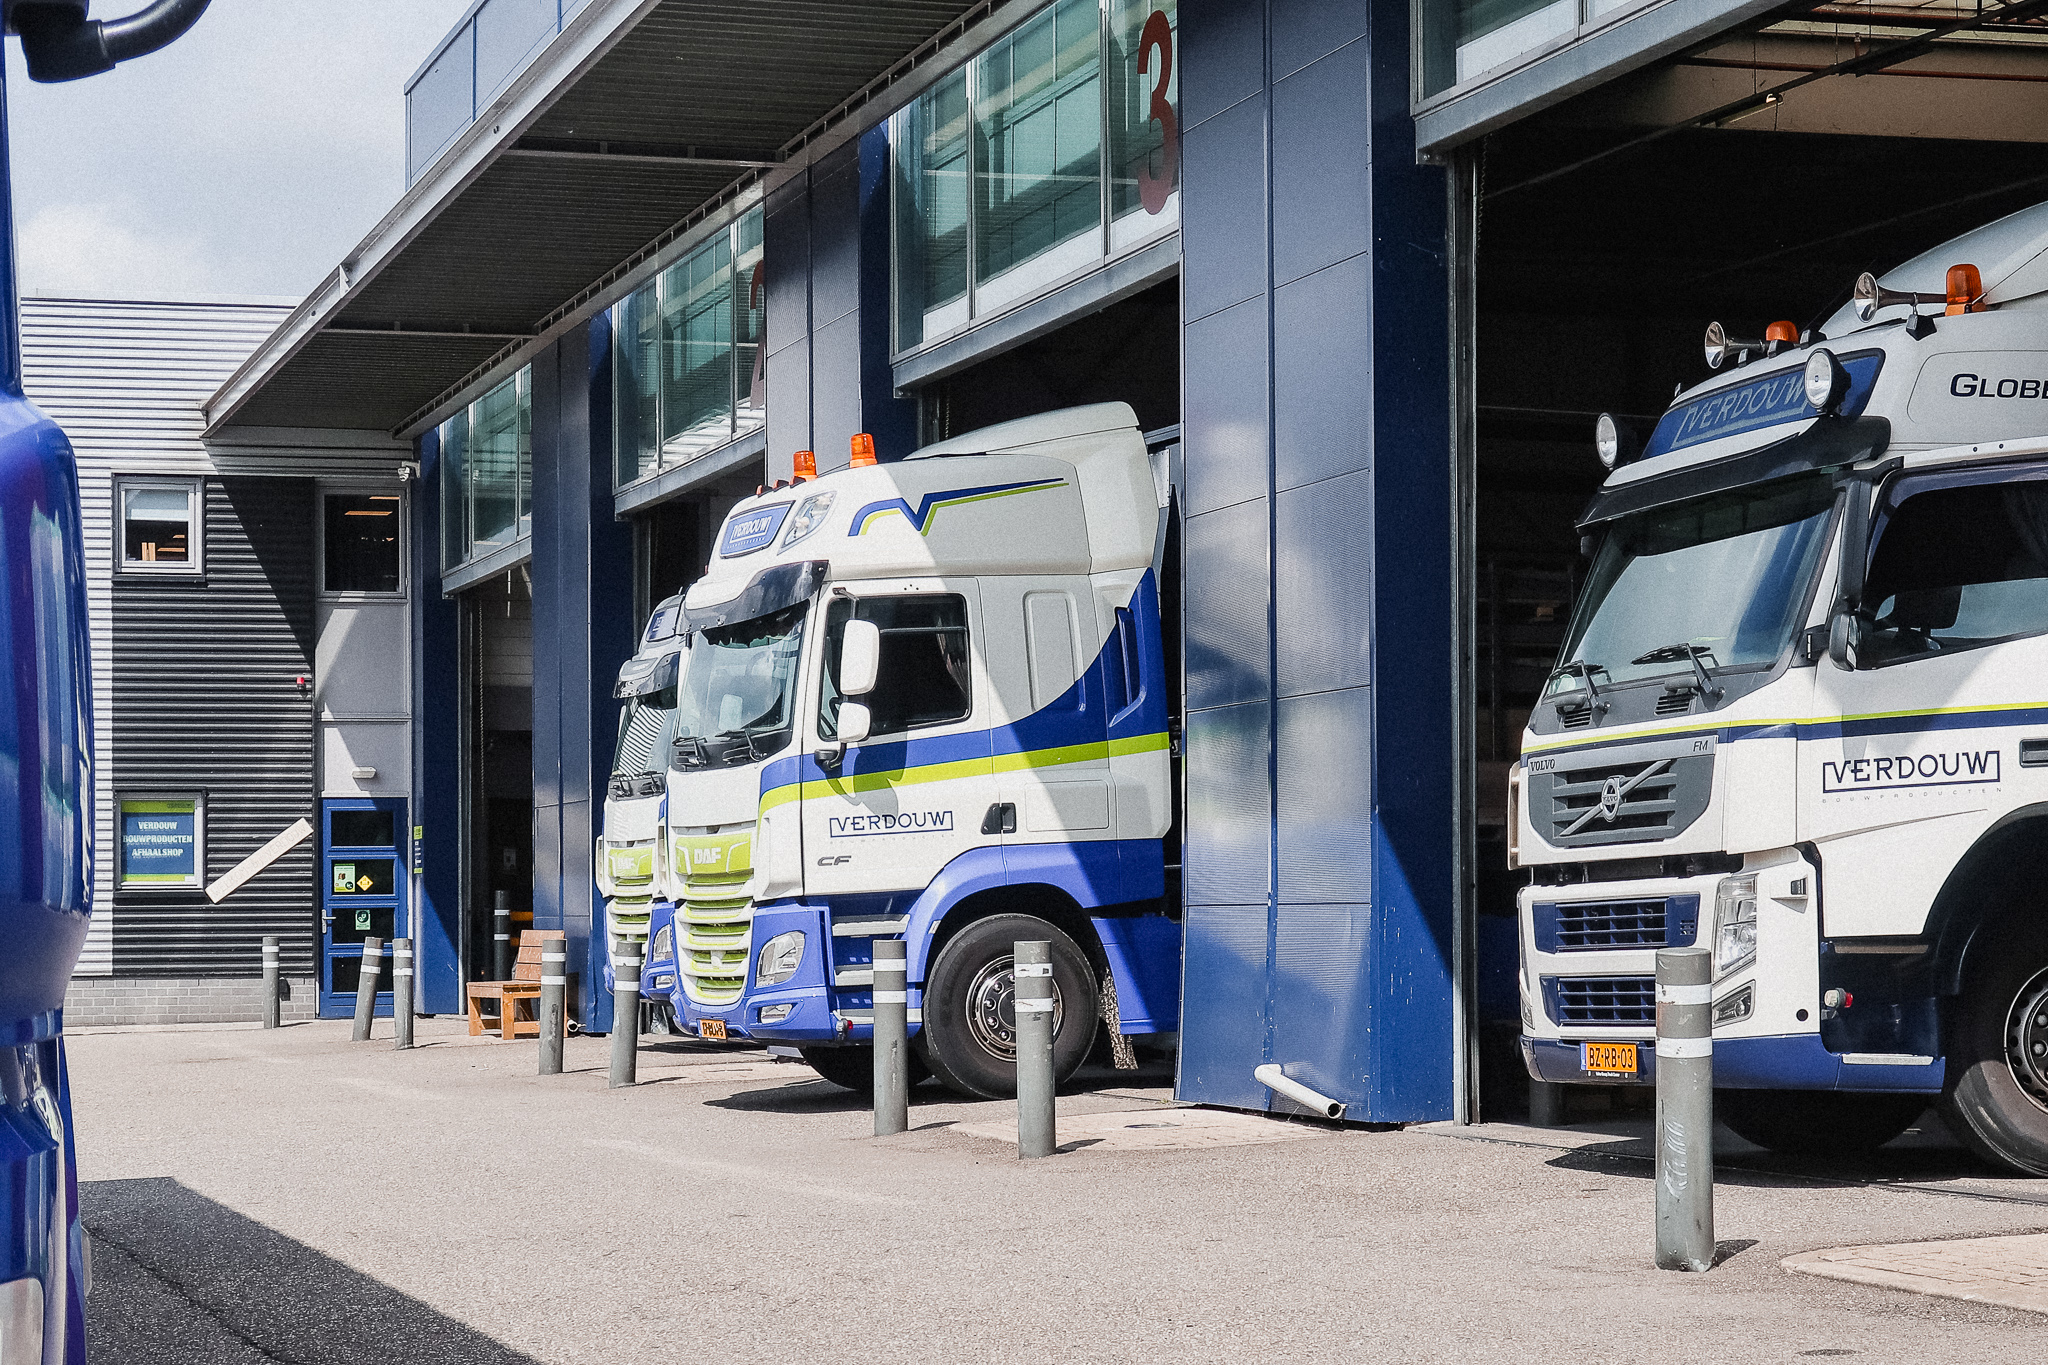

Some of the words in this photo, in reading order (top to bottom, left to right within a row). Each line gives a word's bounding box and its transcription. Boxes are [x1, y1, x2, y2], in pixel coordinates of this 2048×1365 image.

[1137, 10, 1179, 215] 3
[1686, 373, 1807, 432] VERDOUW
[1692, 740, 1709, 752] FM
[1530, 758, 1556, 771] VOLVO
[1829, 751, 1994, 784] VERDOUW
[1822, 787, 2001, 804] BOUWPRODUCTEN
[138, 821, 177, 830] VERDOUW
[834, 811, 948, 832] VERDOUW
[123, 835, 193, 843] BOUWPRODUCTEN
[132, 848, 184, 856] AFHAALSHOP
[694, 847, 722, 865] DAF
[817, 855, 852, 866] CF
